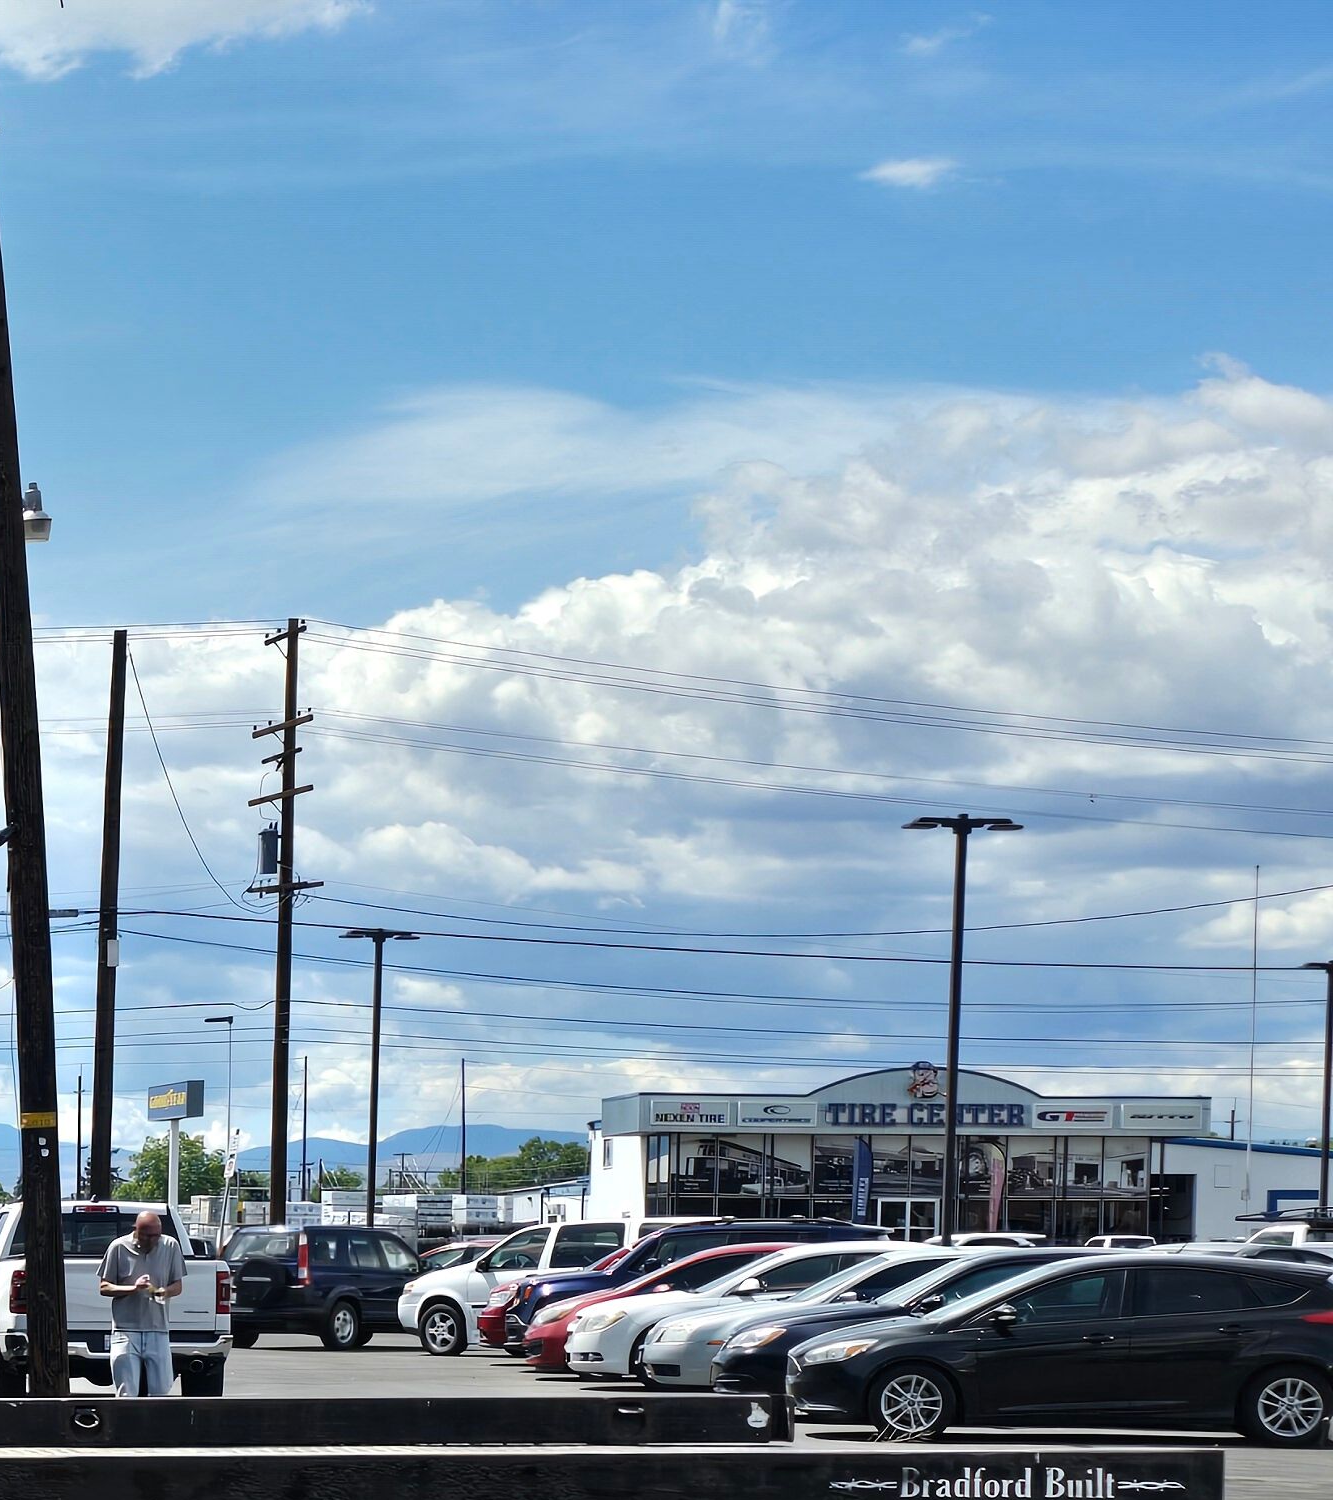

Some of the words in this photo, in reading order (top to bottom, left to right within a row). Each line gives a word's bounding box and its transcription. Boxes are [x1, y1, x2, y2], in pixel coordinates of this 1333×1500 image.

[699, 1114, 725, 1123] TIRE
[827, 1103, 897, 1126] TIRE
[899, 1466, 1032, 1498] Bradford
[1044, 1466, 1115, 1498] Built
